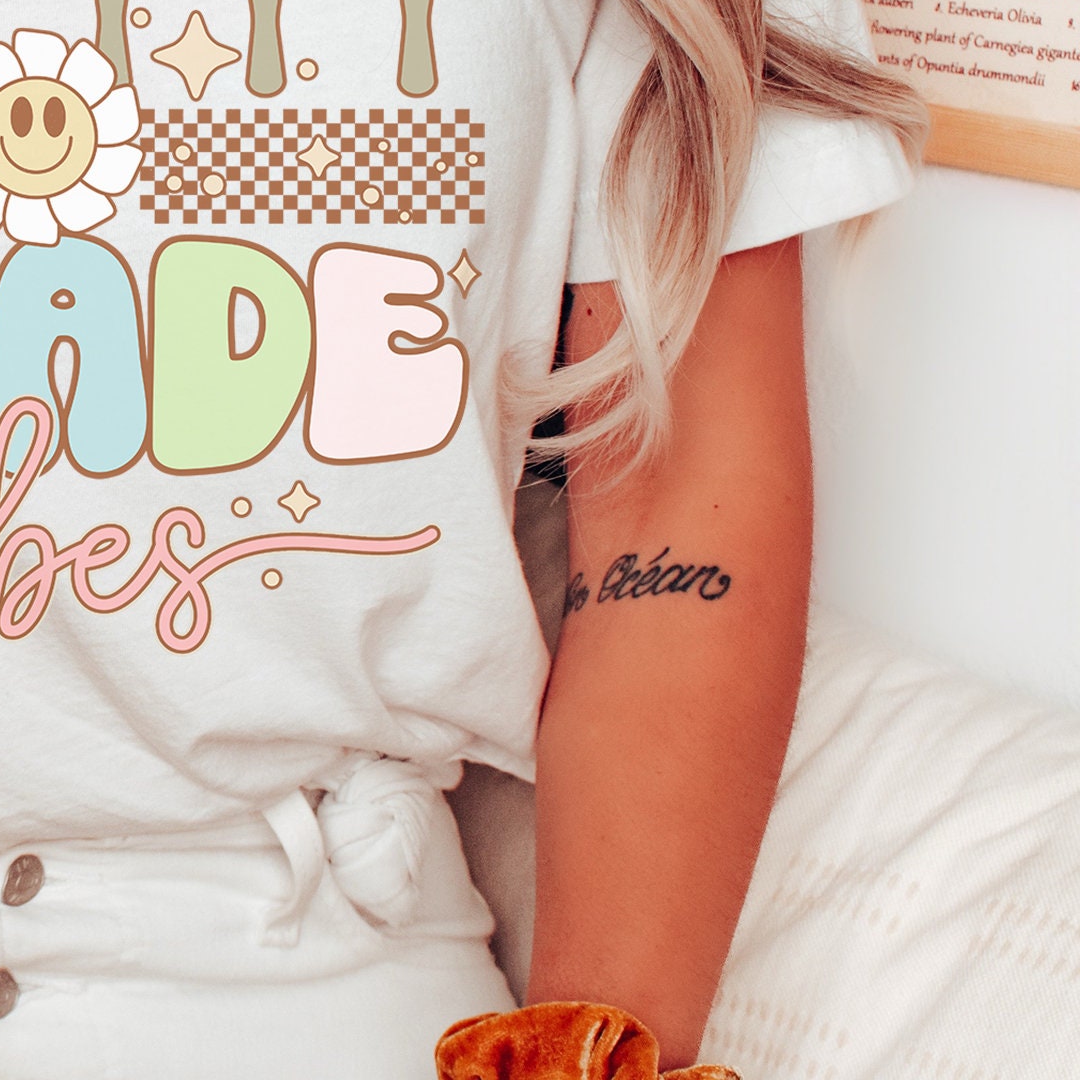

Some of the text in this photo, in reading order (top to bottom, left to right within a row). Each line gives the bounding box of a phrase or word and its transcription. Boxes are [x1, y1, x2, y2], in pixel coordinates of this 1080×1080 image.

[948, 1, 1003, 21] Echeveria
[1007, 8, 1042, 26] Olivia
[925, 28, 955, 44] plant
[958, 32, 974, 50] of
[973, 34, 1033, 57] Carnegiea
[902, 54, 917, 72] of
[917, 56, 965, 75] Opuntia
[968, 62, 1046, 87] drummondii
